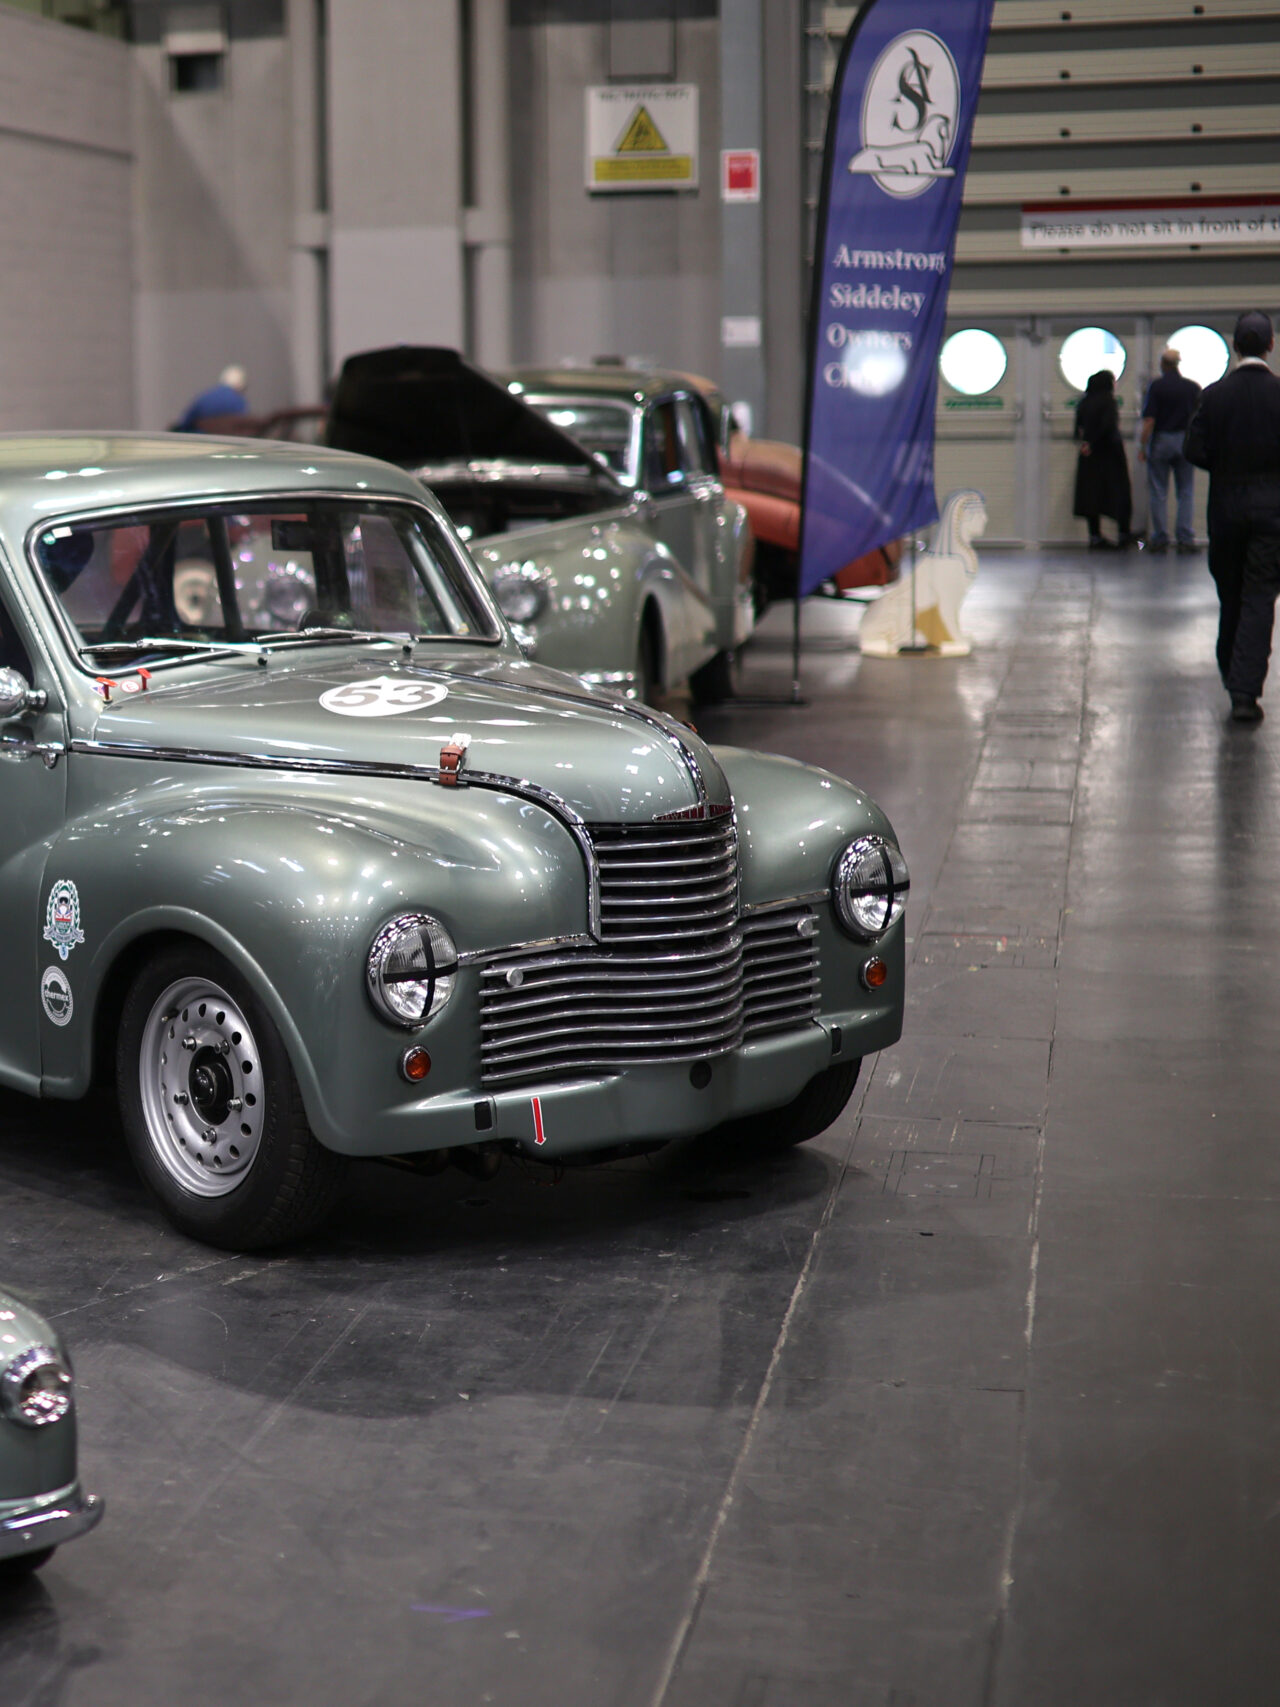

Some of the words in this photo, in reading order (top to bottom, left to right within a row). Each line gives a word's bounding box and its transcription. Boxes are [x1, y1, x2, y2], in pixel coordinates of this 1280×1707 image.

[1031, 220, 1085, 239] Please
[1091, 219, 1113, 237] do
[1120, 221, 1146, 236] not
[1152, 218, 1172, 234] sit
[1178, 218, 1193, 234] in
[1198, 215, 1241, 233] front
[1247, 214, 1267, 232] of
[830, 283, 926, 317] Siddeley
[826, 322, 912, 350] Owners
[329, 684, 436, 708] 53
